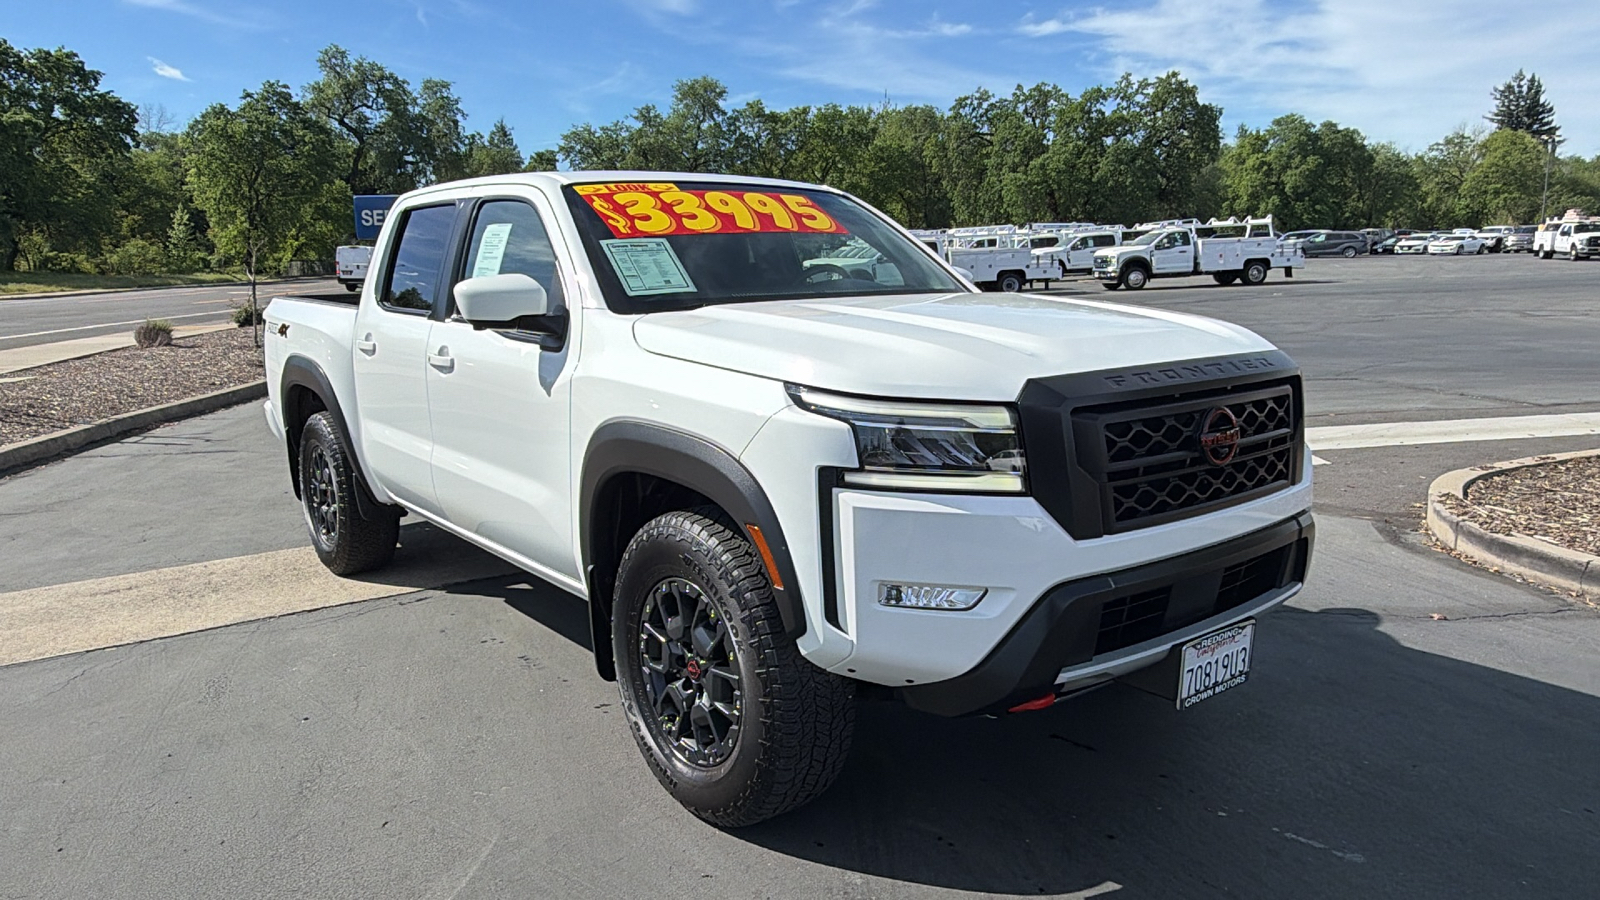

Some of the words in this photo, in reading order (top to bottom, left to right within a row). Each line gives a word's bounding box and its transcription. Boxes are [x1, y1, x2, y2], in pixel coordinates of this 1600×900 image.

[603, 184, 651, 193] LOOK
[590, 191, 837, 234] $33995
[1104, 357, 1276, 389] FRONTIER
[1201, 427, 1240, 446] NISSA
[1201, 628, 1239, 648] REDDING
[1186, 646, 1248, 698] 70819U3
[1185, 687, 1214, 708] CROWN
[1214, 674, 1247, 695] MOTORS
